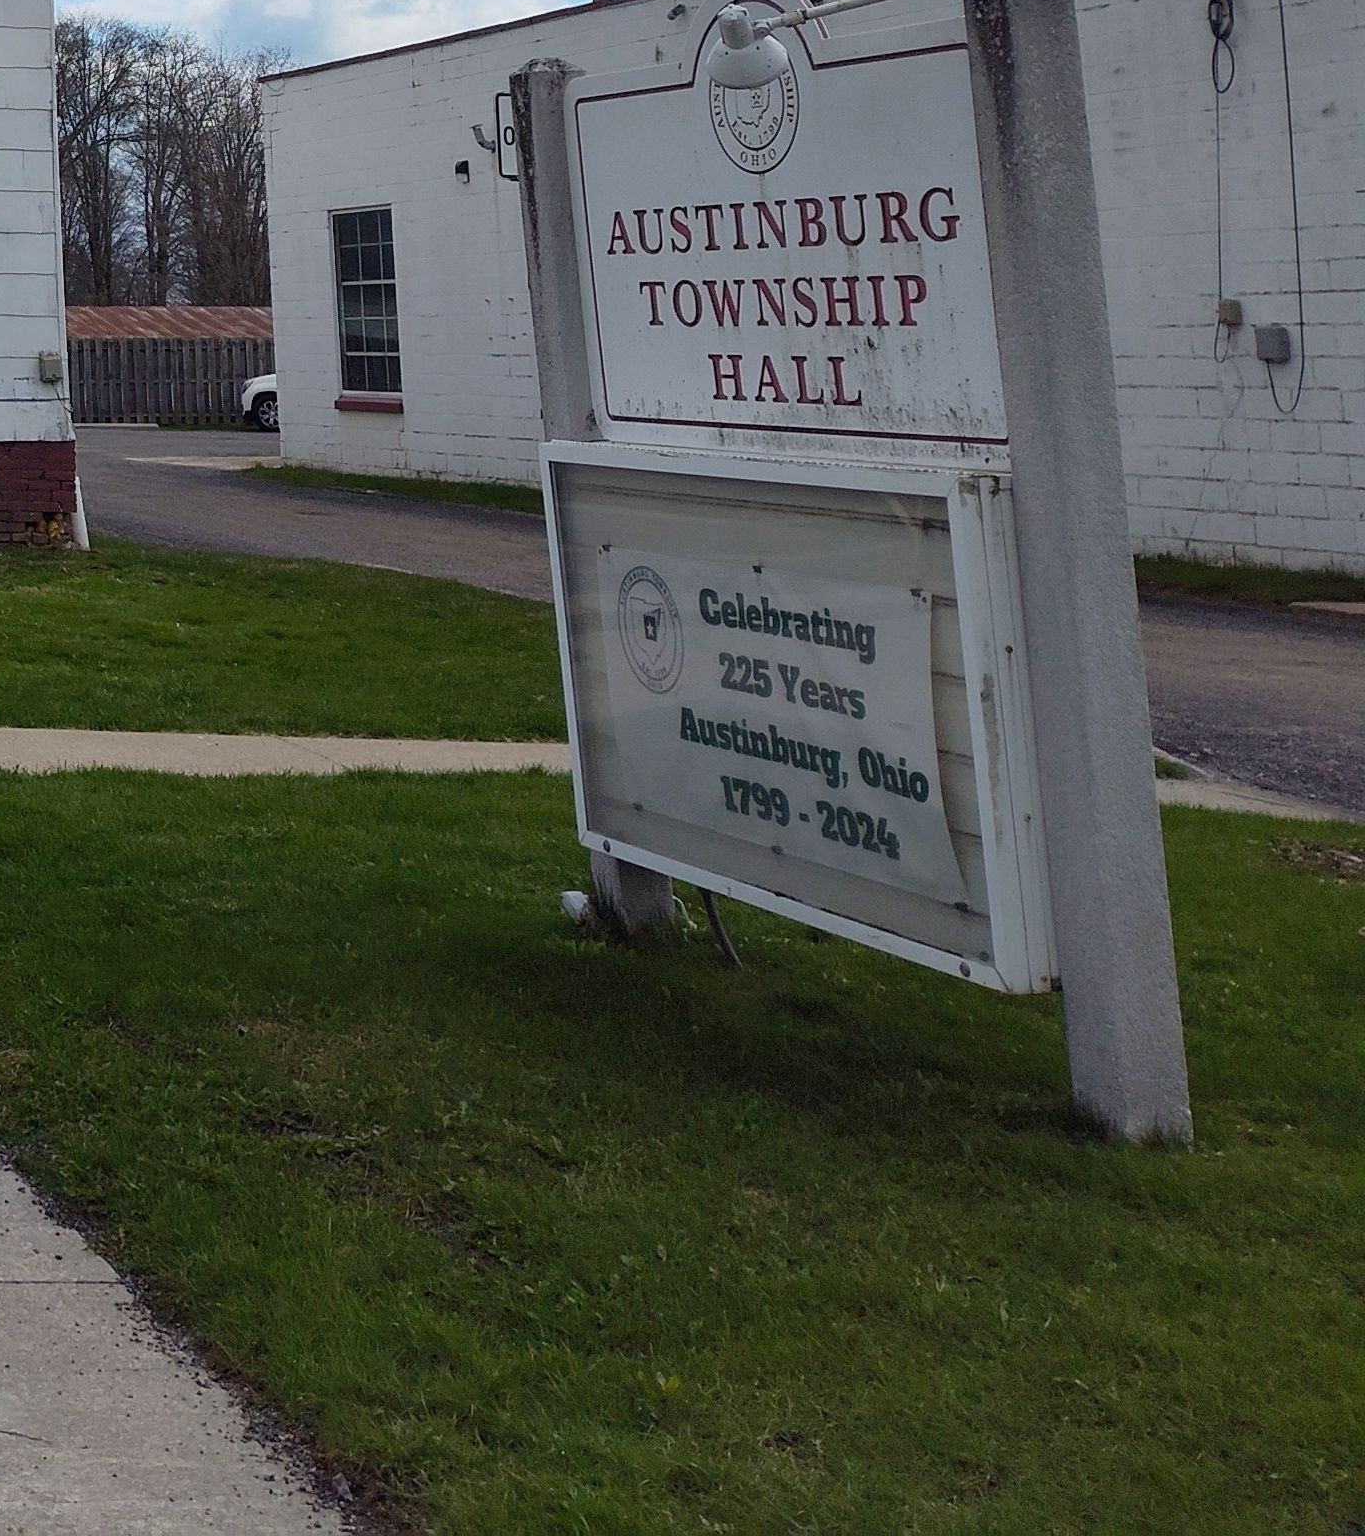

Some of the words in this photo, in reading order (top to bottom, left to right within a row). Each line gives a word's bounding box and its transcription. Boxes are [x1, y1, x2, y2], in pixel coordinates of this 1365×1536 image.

[740, 148, 777, 166] OHIO
[607, 187, 960, 255] AUSTINBURG
[639, 274, 928, 328] TOWNSHIP
[707, 354, 863, 407] HALL
[699, 587, 876, 665] Celebrating
[718, 652, 773, 698] 225
[777, 663, 866, 720] Years
[680, 706, 849, 789] Austinburg,
[858, 746, 930, 803] Ohio
[720, 775, 791, 827] 1799
[799, 812, 811, 824] -
[816, 800, 901, 861] 2024
